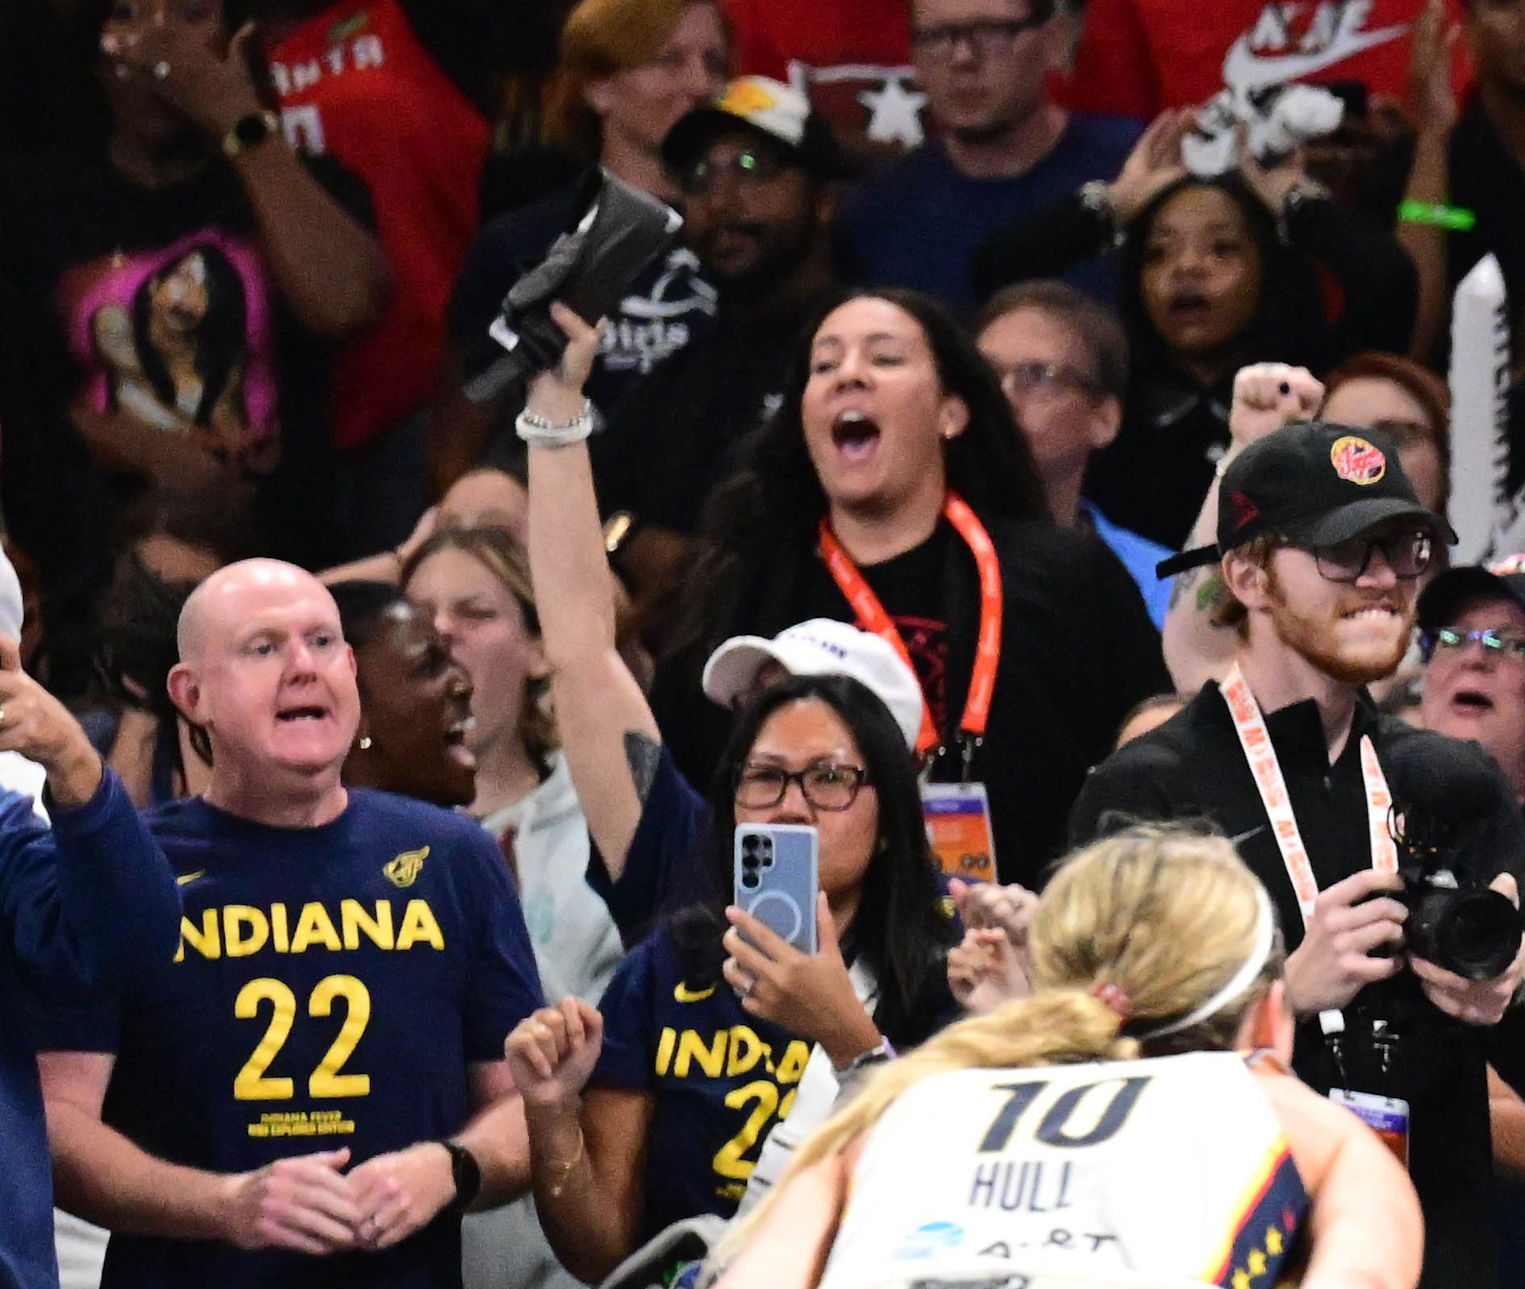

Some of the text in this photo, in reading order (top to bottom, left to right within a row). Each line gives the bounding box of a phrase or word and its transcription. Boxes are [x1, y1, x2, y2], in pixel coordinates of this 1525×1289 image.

[172, 898, 445, 963] NDIANA
[233, 974, 371, 1101] 22
[712, 1079, 797, 1180] 2
[976, 1074, 1155, 1154] 10
[968, 1160, 1073, 1213] HULL
